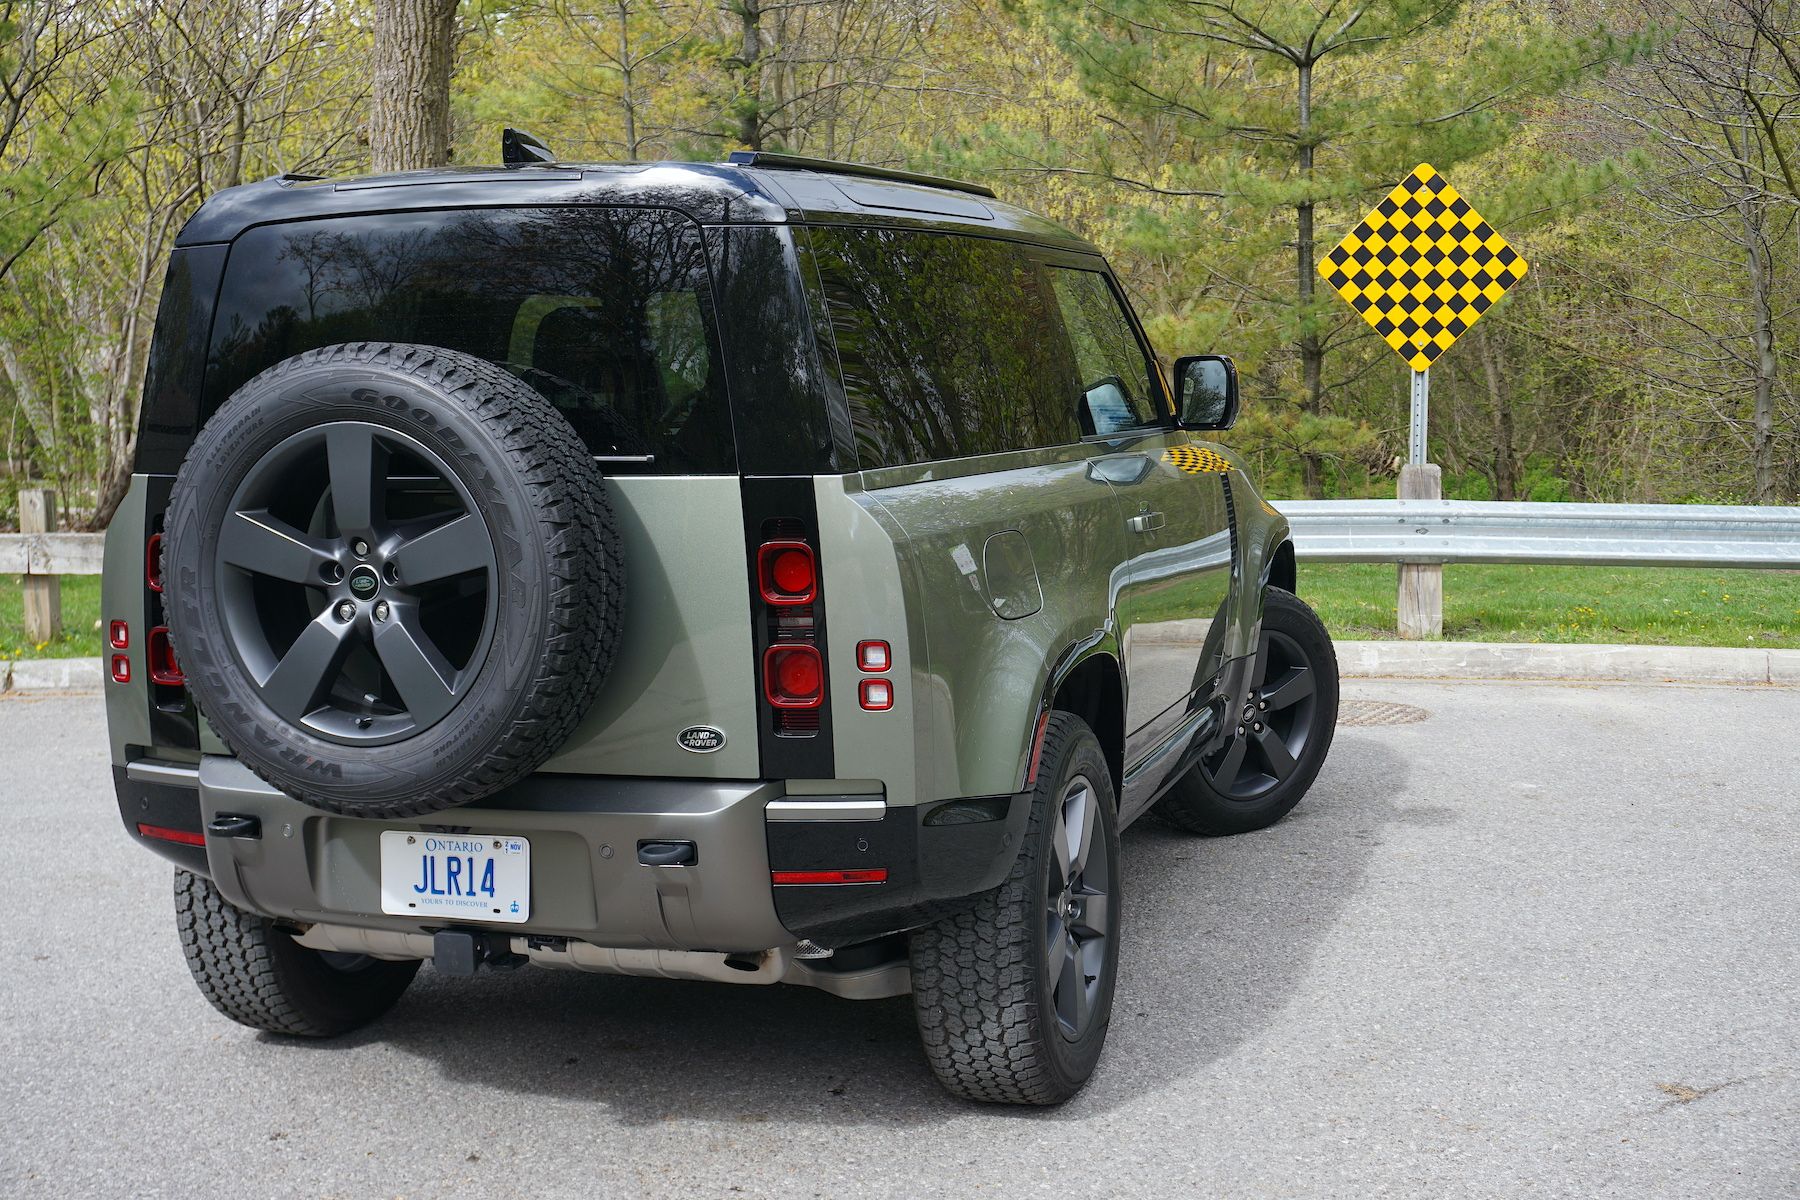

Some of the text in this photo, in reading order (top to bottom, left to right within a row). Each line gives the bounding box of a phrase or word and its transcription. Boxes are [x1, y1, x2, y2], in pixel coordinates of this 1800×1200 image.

[215, 418, 264, 472] ADVENTURE
[351, 388, 526, 607] GOODYEAR
[180, 566, 344, 778] WRANGLER
[687, 731, 710, 739] LAND
[689, 739, 717, 747] ROVER
[426, 838, 483, 853] ONTARIO
[413, 855, 495, 898] JLR14
[456, 900, 488, 908] DISCOVER
